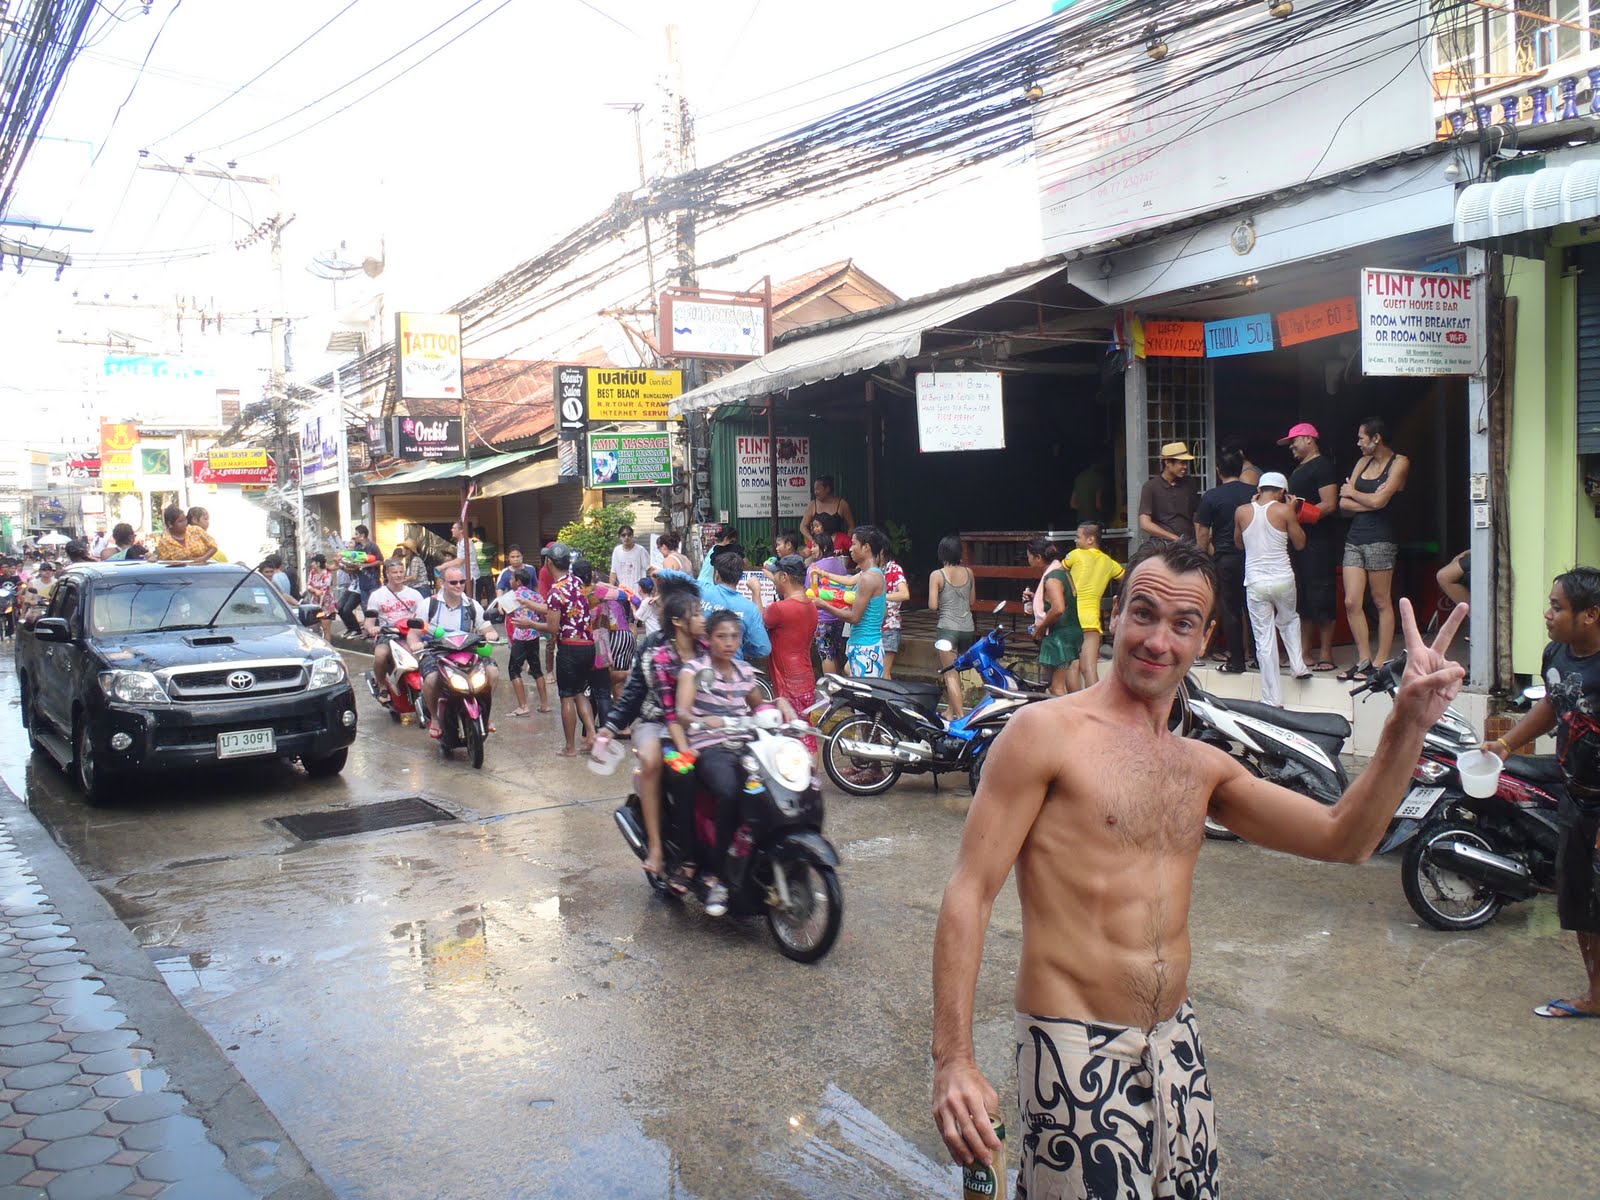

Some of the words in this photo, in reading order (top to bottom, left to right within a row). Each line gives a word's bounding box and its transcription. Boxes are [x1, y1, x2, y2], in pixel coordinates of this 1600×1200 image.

[1367, 273, 1415, 297] FLINT
[1420, 277, 1472, 300] STONE
[1383, 298, 1407, 309] GUEST
[1409, 300, 1434, 311] HOUSE
[1436, 301, 1441, 311] &
[1442, 302, 1459, 312] BAR
[1370, 315, 1397, 327] ROOM
[1400, 315, 1423, 328] WITH
[1425, 316, 1471, 329] BREAKFAST
[1157, 324, 1184, 336] HAPPY
[1209, 327, 1240, 350] TEQUILA
[1247, 322, 1263, 345] 50
[1375, 330, 1388, 342] OR
[1391, 330, 1417, 342] ROOM
[1419, 331, 1442, 343] ONLY
[403, 331, 457, 356] TATTOO
[1188, 339, 1204, 352] DAY
[560, 371, 583, 387] Beauty
[562, 384, 581, 398] Salon
[597, 388, 614, 399] BEST
[617, 389, 640, 399] BEACH
[414, 421, 449, 441] Orchid
[592, 438, 619, 451] AMIN
[622, 437, 669, 450] MASSAGE
[738, 438, 769, 454] FLINT
[636, 449, 667, 457] MASSAGE
[742, 456, 761, 465] GUEST
[632, 464, 663, 472] MASSAGE
[739, 466, 757, 475] ROOM
[759, 466, 770, 475] WIT
[639, 472, 670, 480] MASSAGE
[741, 478, 750, 487] OR
[751, 478, 770, 487] ROOM
[243, 732, 270, 745] 3091
